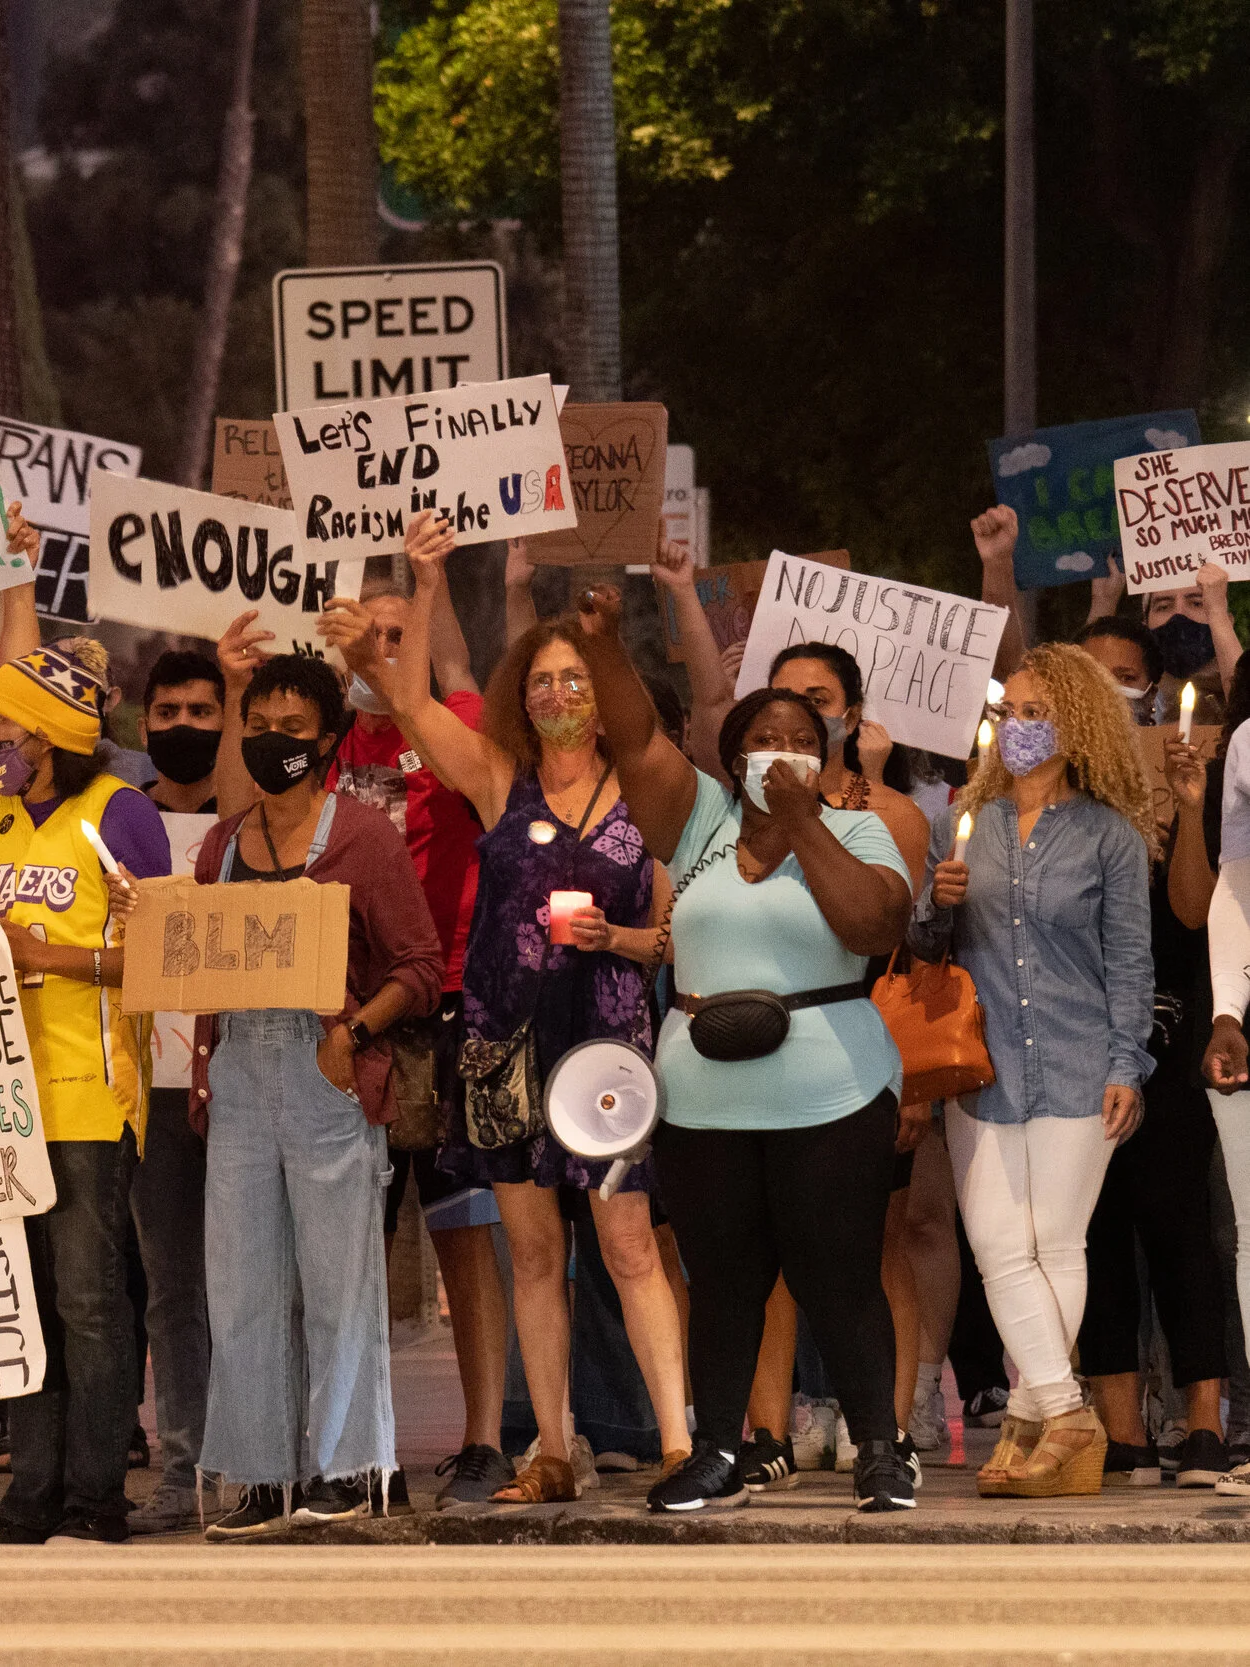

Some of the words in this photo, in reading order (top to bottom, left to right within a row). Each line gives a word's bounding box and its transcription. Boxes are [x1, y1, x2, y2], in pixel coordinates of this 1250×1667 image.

[306, 296, 475, 340] SPEED
[313, 354, 470, 399] LIMIT
[356, 443, 440, 489] END
[1135, 453, 1179, 481] SHE
[499, 464, 566, 516] USA
[1135, 525, 1162, 548] SO
[1171, 513, 1222, 541] MUCH
[1129, 553, 1199, 586] JUSTICE
[775, 560, 824, 610] NO
[822, 574, 998, 661] JUSTICE
[864, 635, 969, 719] PEACE
[284, 757, 308, 773] VOTE
[161, 910, 298, 978] BLM
